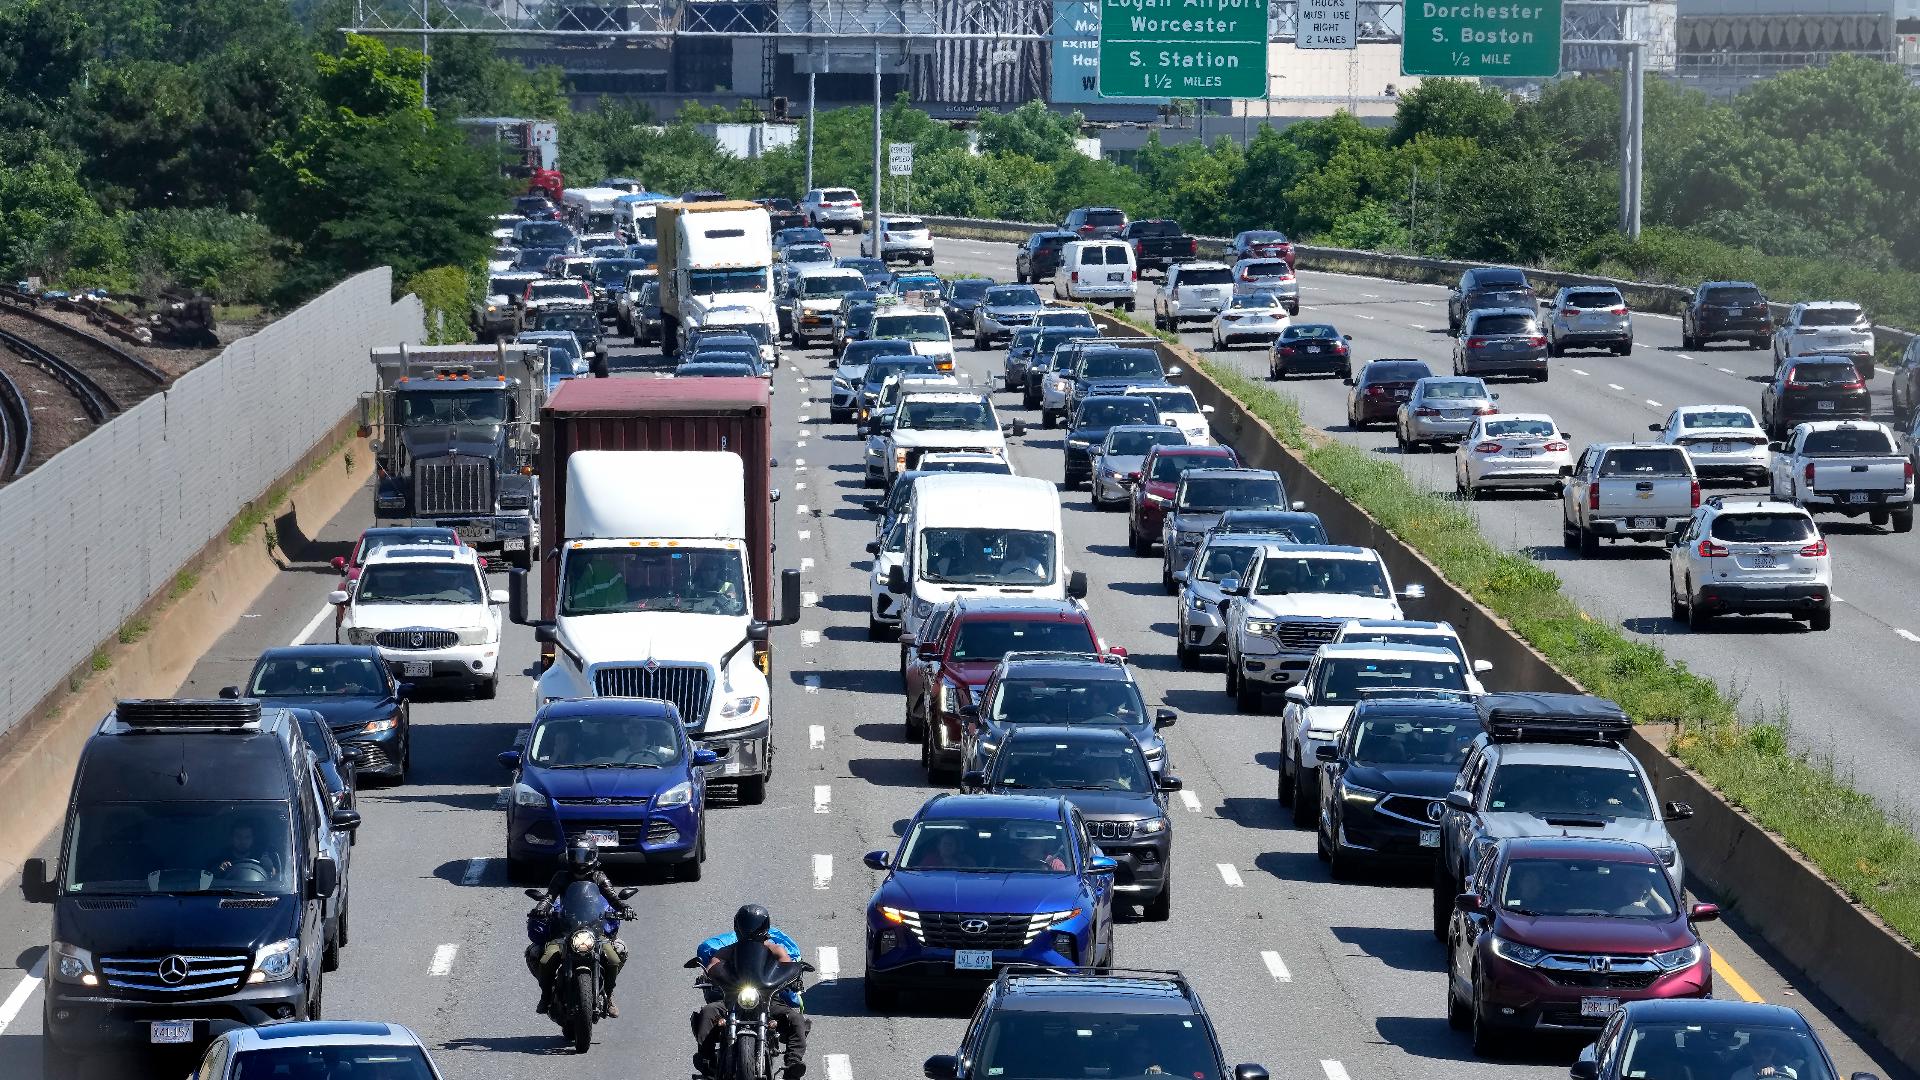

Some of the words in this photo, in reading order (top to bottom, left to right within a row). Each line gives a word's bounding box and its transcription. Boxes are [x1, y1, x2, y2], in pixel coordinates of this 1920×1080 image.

[1303, 11, 1326, 19] MUST
[1333, 11, 1350, 20] USE
[1423, 2, 1543, 19] Dorchester
[1131, 15, 1237, 33] Worcester
[1313, 23, 1339, 32] RIGHT
[1306, 35, 1312, 44] 2
[1317, 35, 1347, 44] LANES
[1431, 26, 1449, 43] S.
[1461, 27, 1533, 44] Boston
[1129, 50, 1146, 67] S.
[1159, 50, 1239, 68] Station
[1481, 53, 1511, 65] MILE
[1183, 75, 1222, 87] MILES
